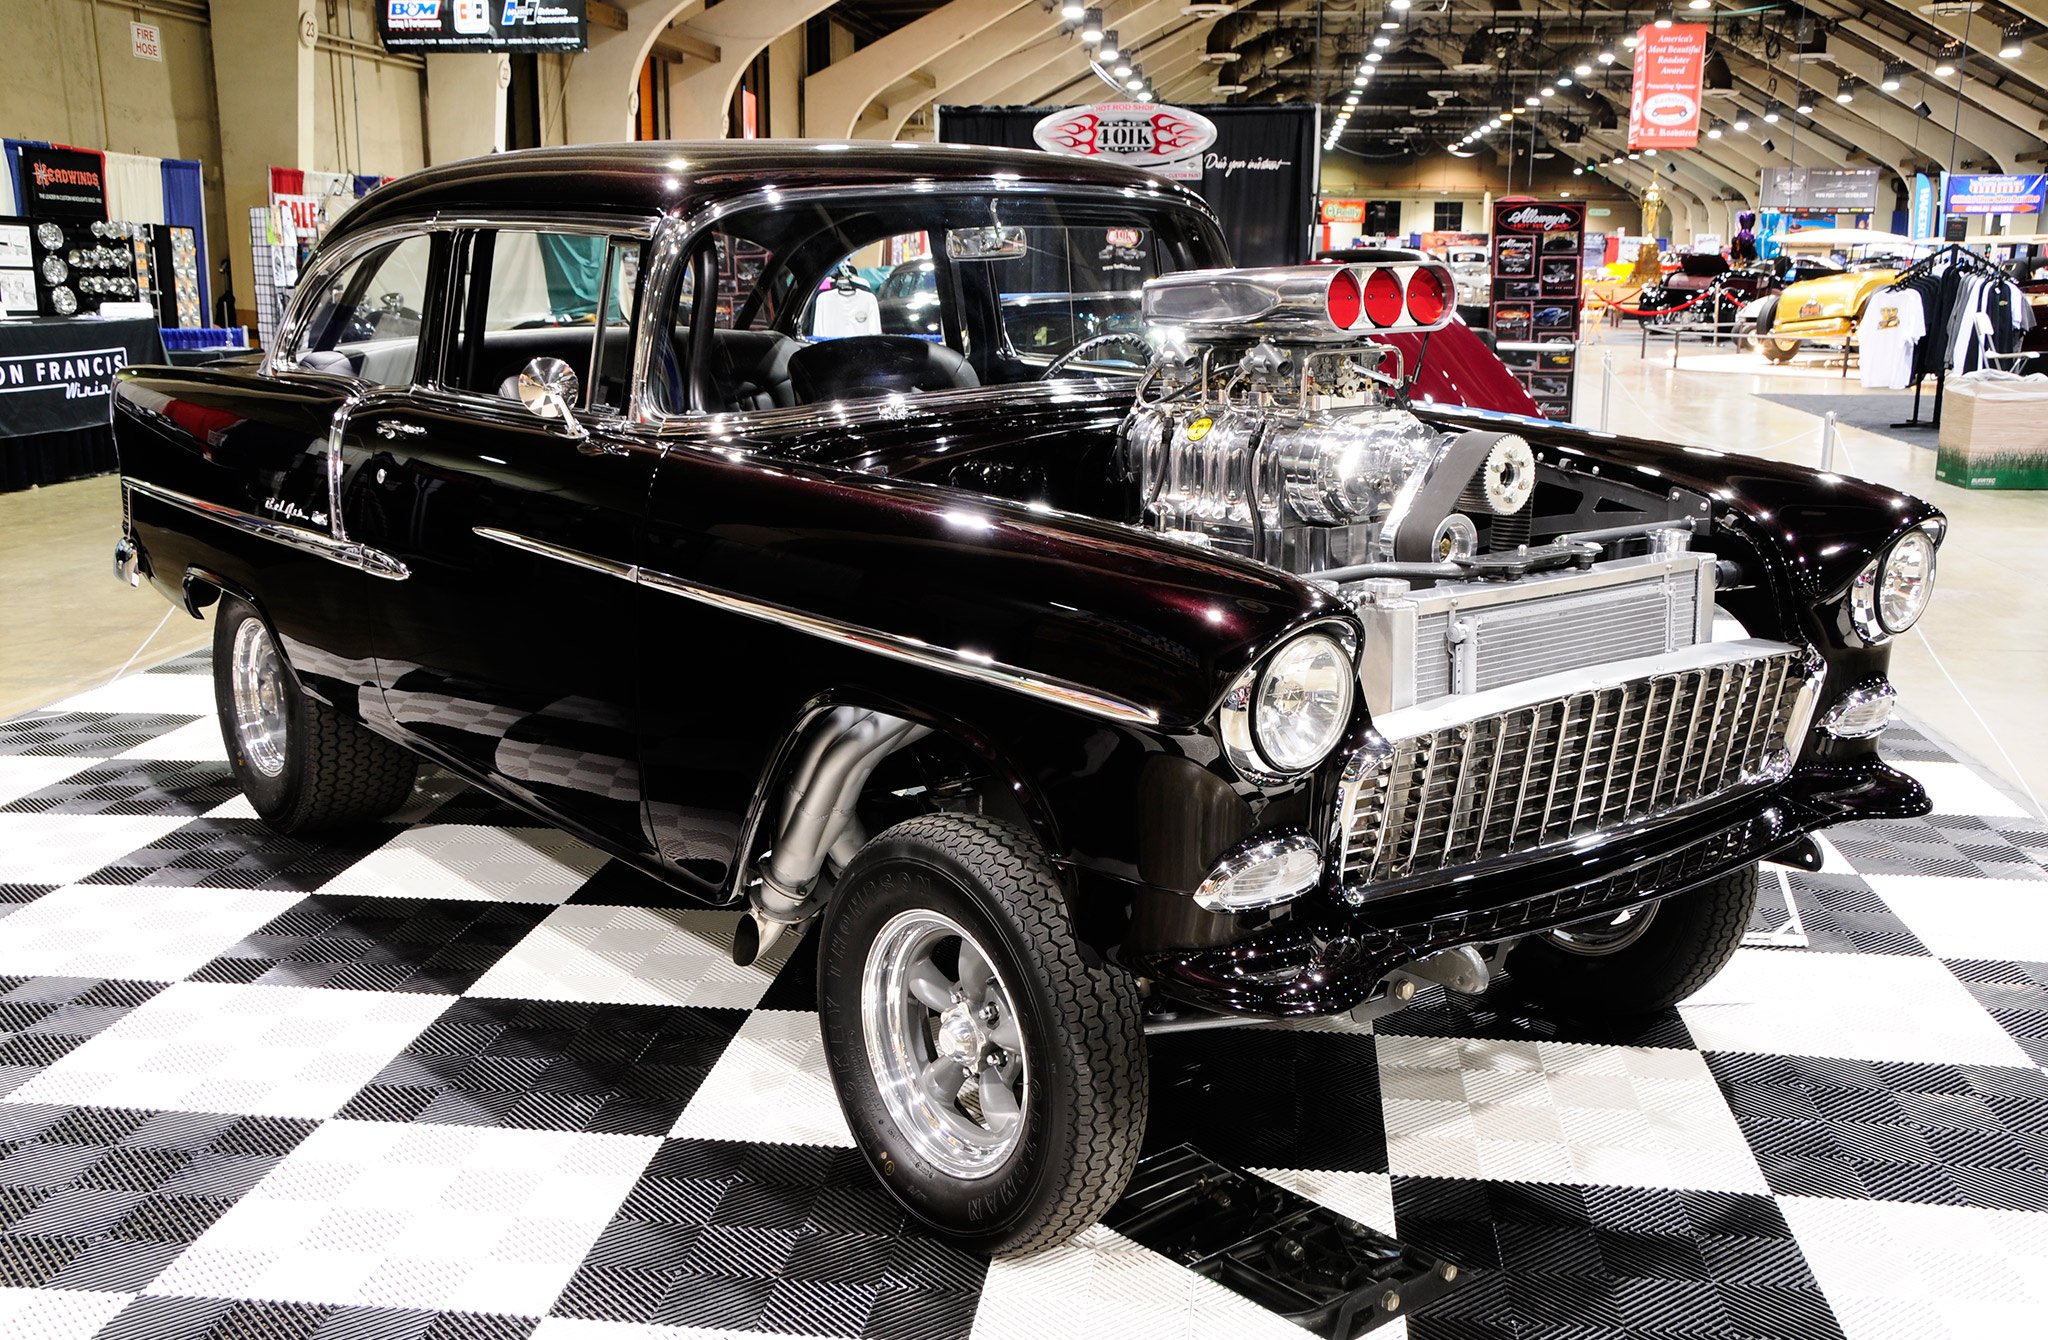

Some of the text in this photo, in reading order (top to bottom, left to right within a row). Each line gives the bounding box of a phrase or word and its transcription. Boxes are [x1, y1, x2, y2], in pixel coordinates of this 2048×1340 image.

[391, 3, 437, 17] B&M
[136, 28, 154, 41] FIRE
[1658, 35, 1693, 43] America's
[136, 42, 158, 56] HOSE
[1648, 45, 1702, 55] Most Beautiful
[1657, 56, 1690, 64] Roadster
[1660, 66, 1685, 75] Award
[1095, 104, 1110, 112] HOT
[36, 354, 123, 382] FRANCIS
